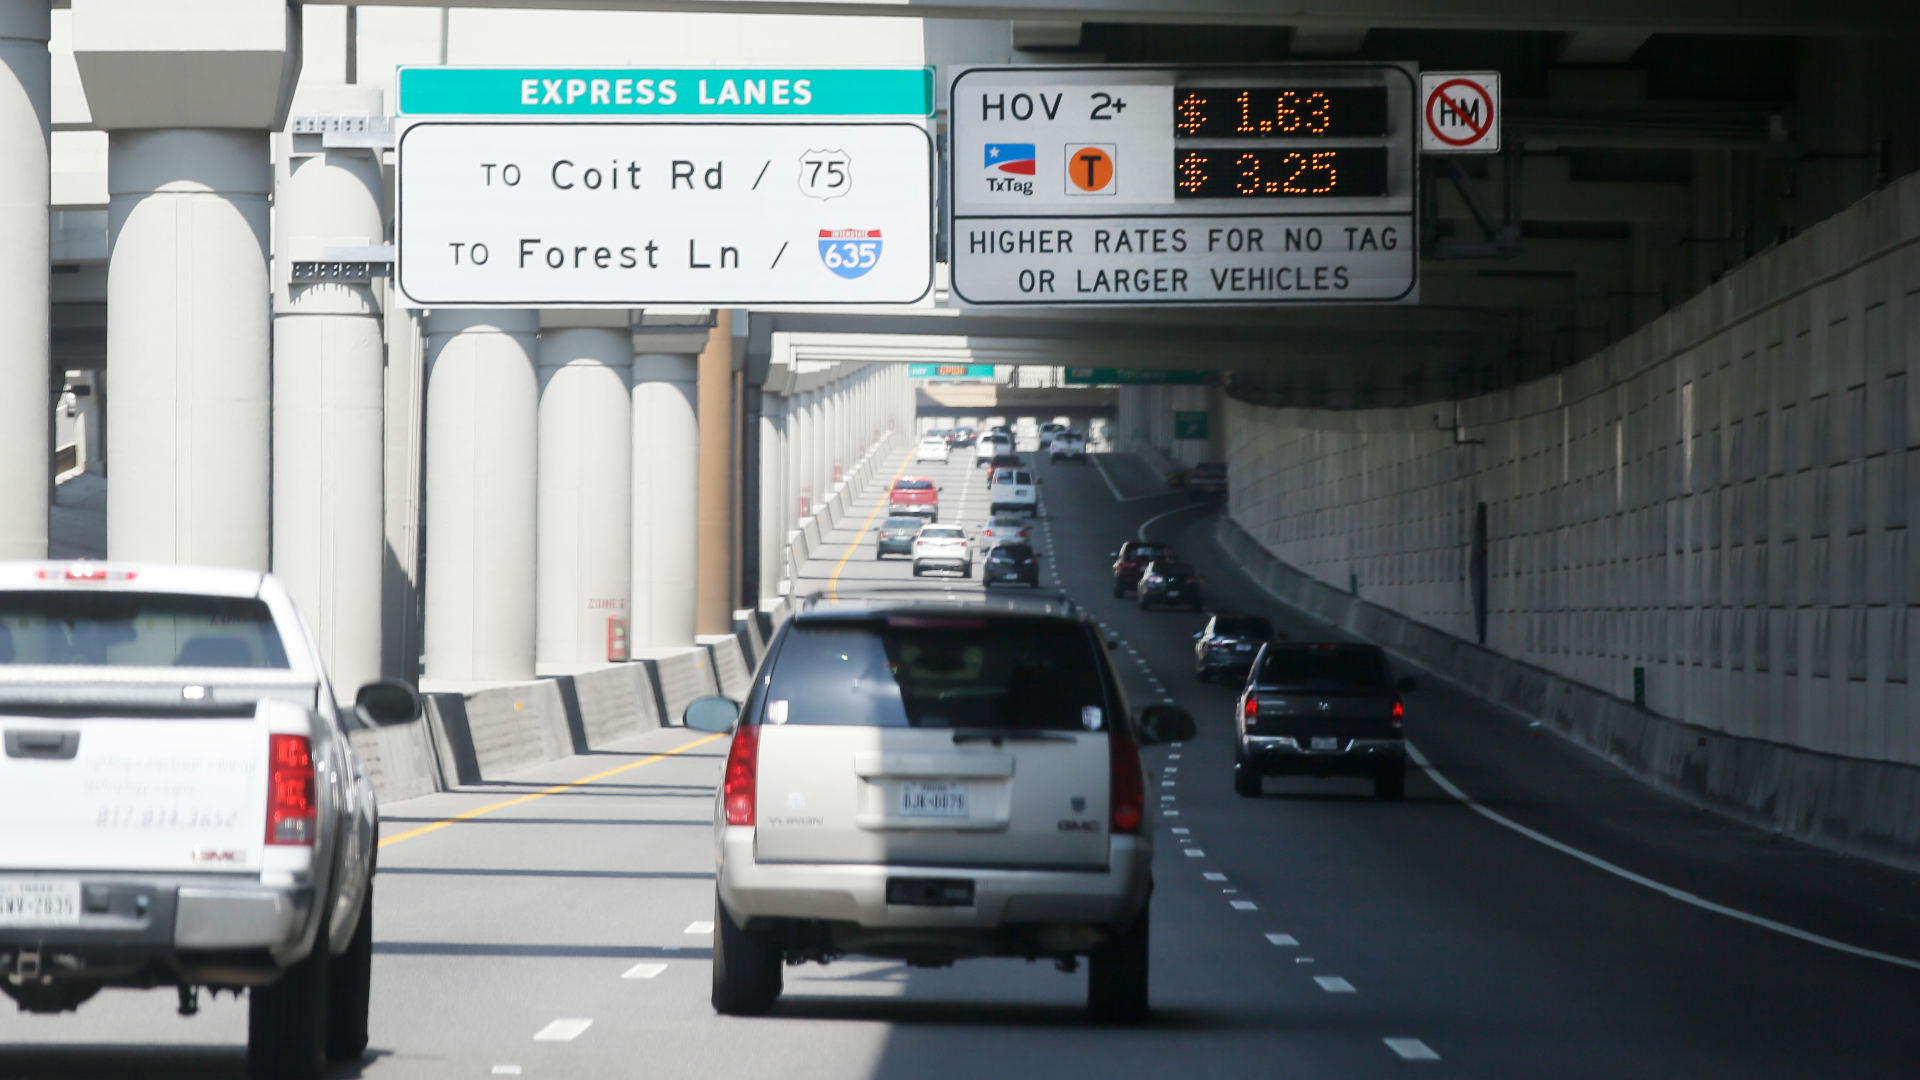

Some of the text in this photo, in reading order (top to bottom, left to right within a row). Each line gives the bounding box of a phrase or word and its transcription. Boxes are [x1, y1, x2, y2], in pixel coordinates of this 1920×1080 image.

[520, 78, 812, 105] EXPRESS LANES
[982, 91, 1127, 121] HOV 2+
[1178, 90, 1331, 134] $ 1.63
[1439, 98, 1480, 127] HM
[481, 159, 845, 191] TO Coit Rd / 75
[1080, 154, 1102, 188] T
[1178, 151, 1337, 195] $ 3.25
[986, 177, 1034, 196] TxTag
[449, 237, 877, 270] TO Forest Ln / 635
[969, 227, 1398, 254] HIGHER RATES FOR NO TAG
[1018, 266, 1349, 293] OR LARGER VEHICLES
[587, 598, 617, 609] ZONE
[1057, 818, 1101, 832] GMC
